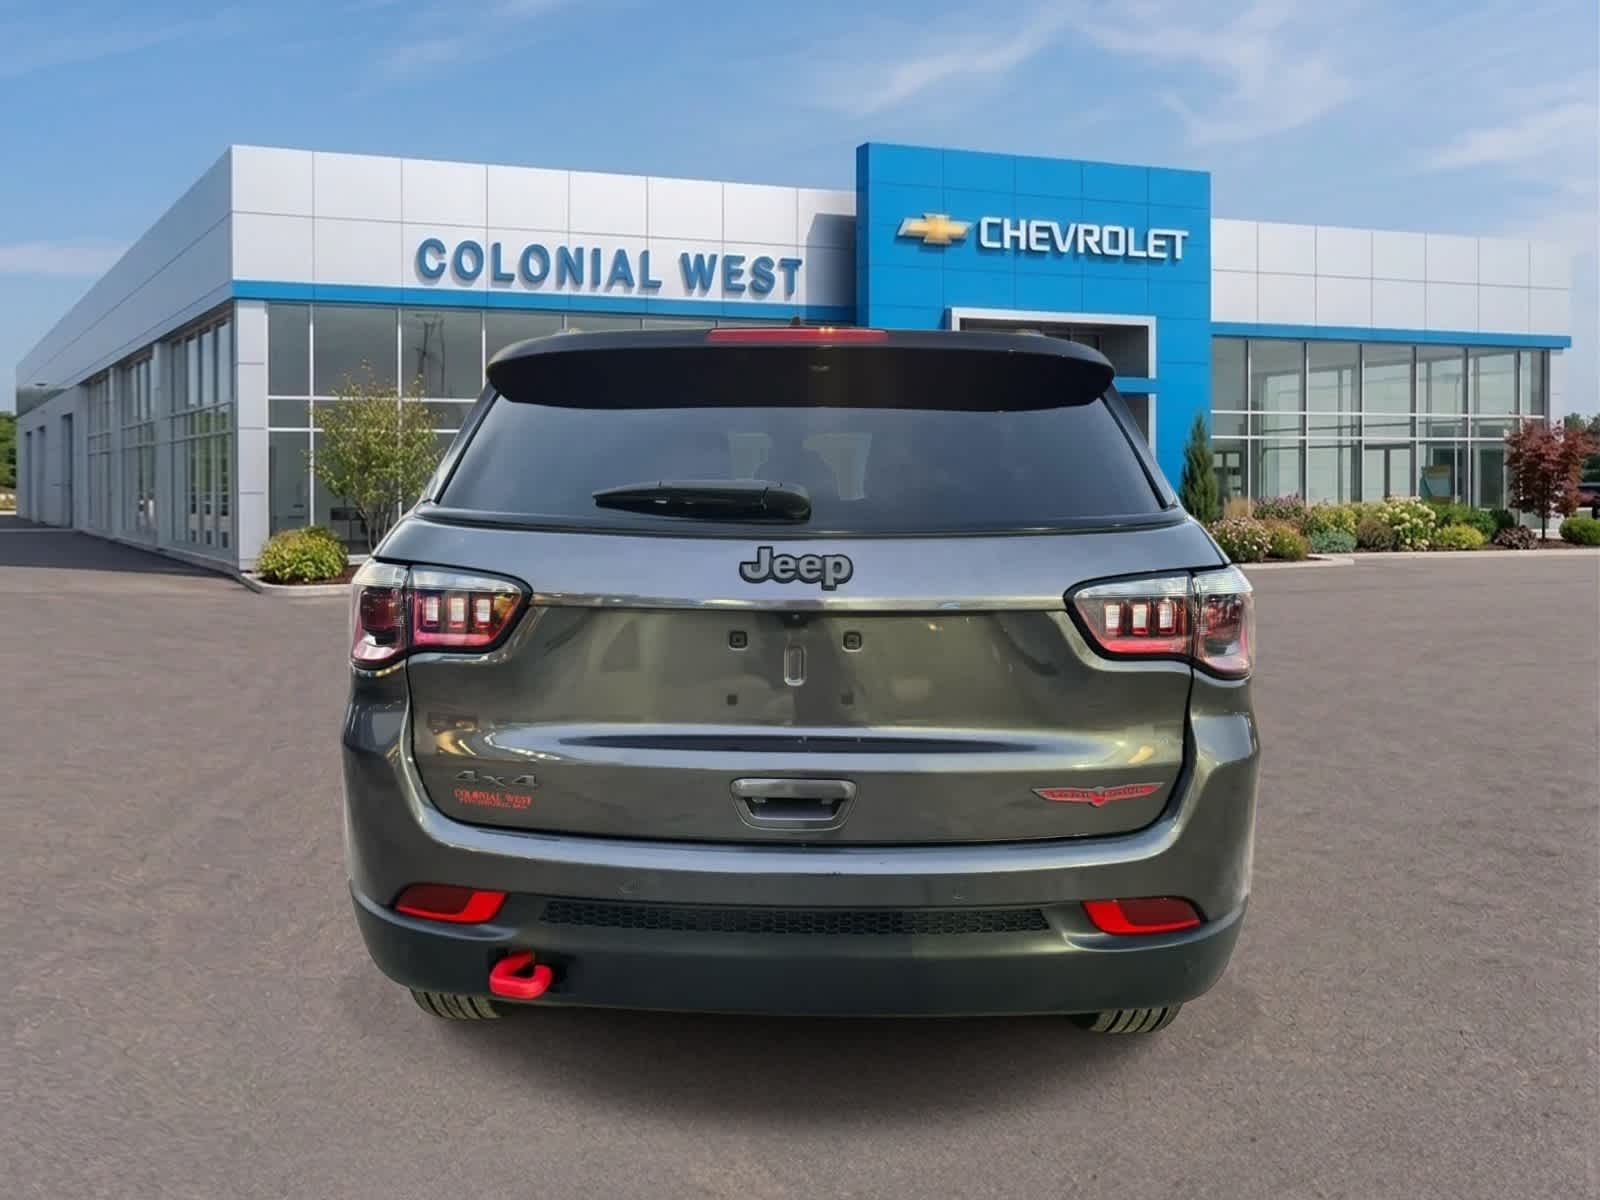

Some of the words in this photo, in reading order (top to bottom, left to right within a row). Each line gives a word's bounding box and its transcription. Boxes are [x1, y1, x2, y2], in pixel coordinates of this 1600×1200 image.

[979, 216, 1190, 260] CHEVROLET
[416, 238, 662, 289] COLONIAL
[680, 252, 803, 296] WEST
[739, 546, 854, 591] Jeep
[456, 770, 538, 788] 4x4
